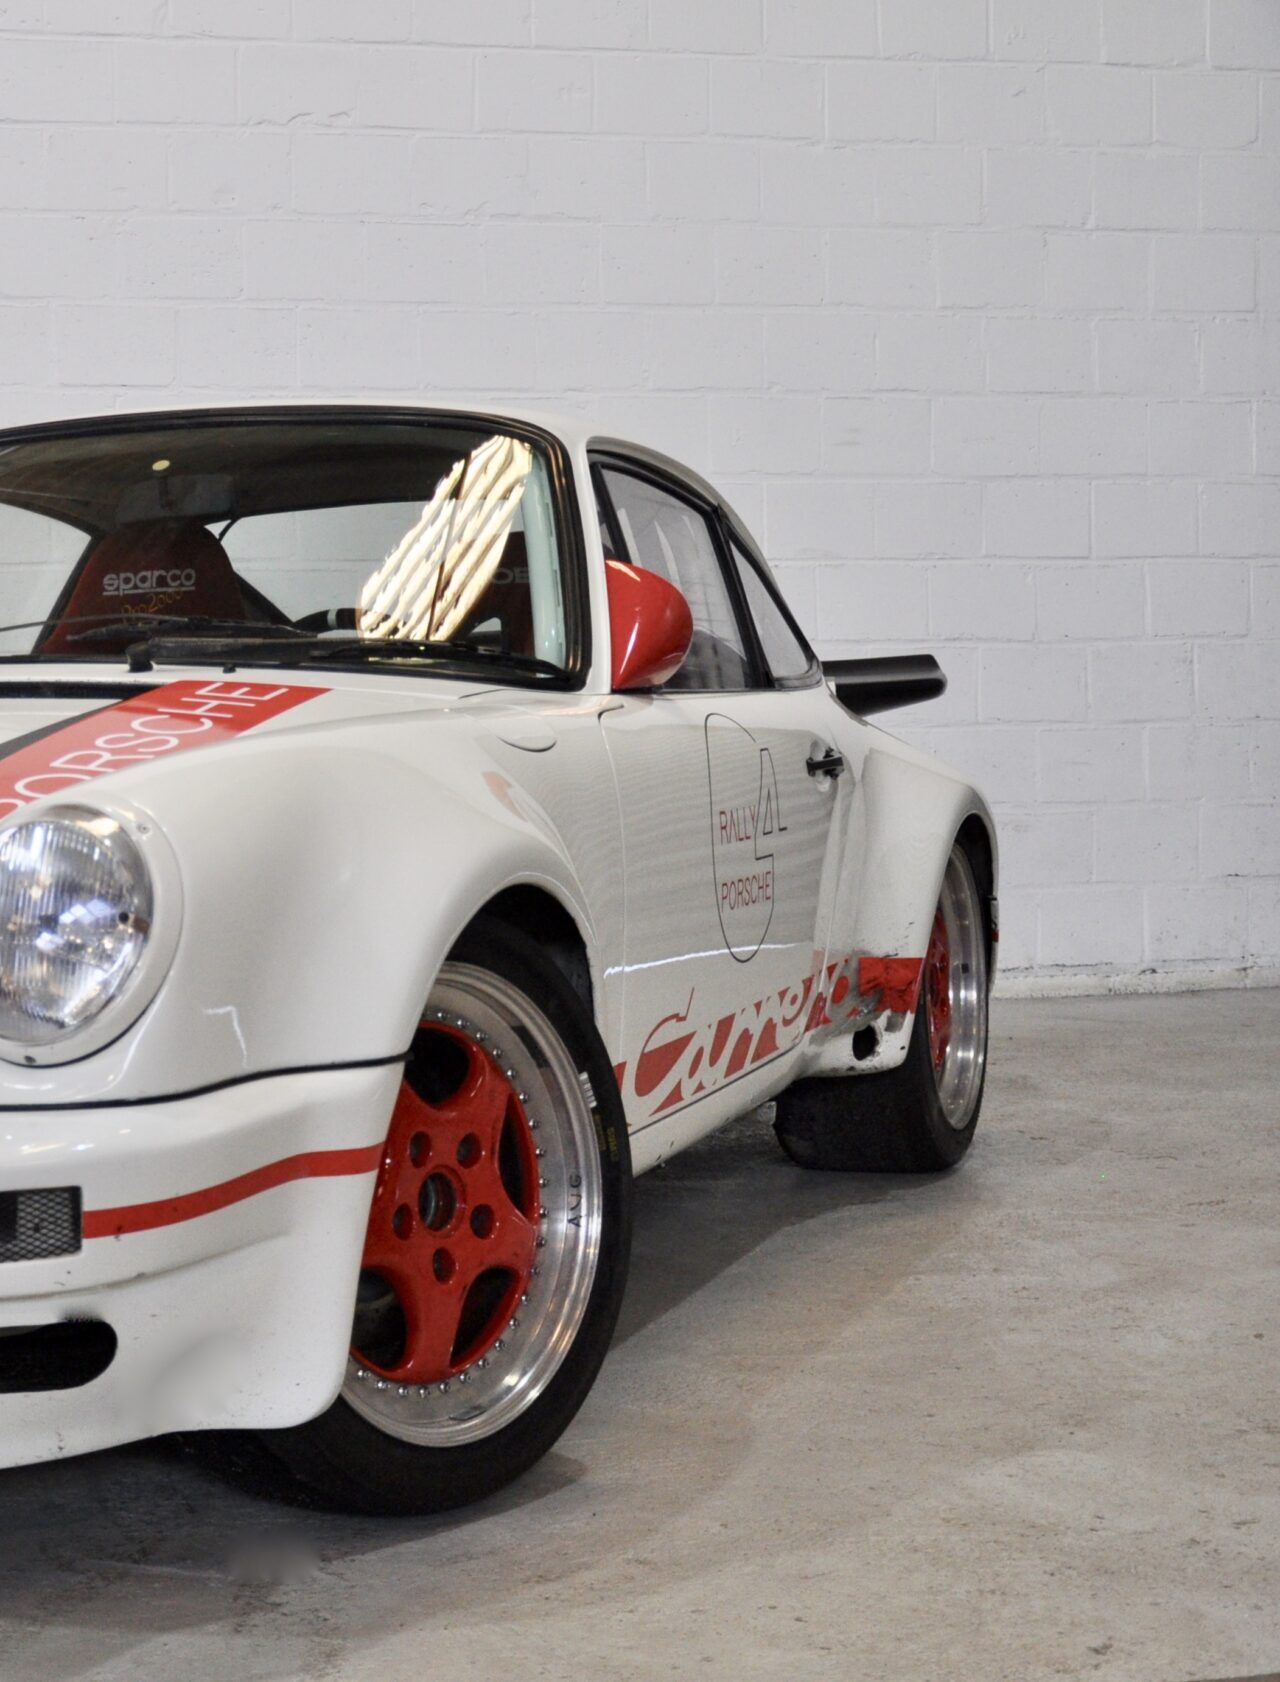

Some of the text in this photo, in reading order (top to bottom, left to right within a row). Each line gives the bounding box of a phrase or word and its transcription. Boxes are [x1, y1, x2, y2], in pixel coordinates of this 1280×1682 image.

[102, 568, 196, 596] sparco
[719, 805, 757, 846] RALLY
[721, 871, 773, 913] PORSCHE
